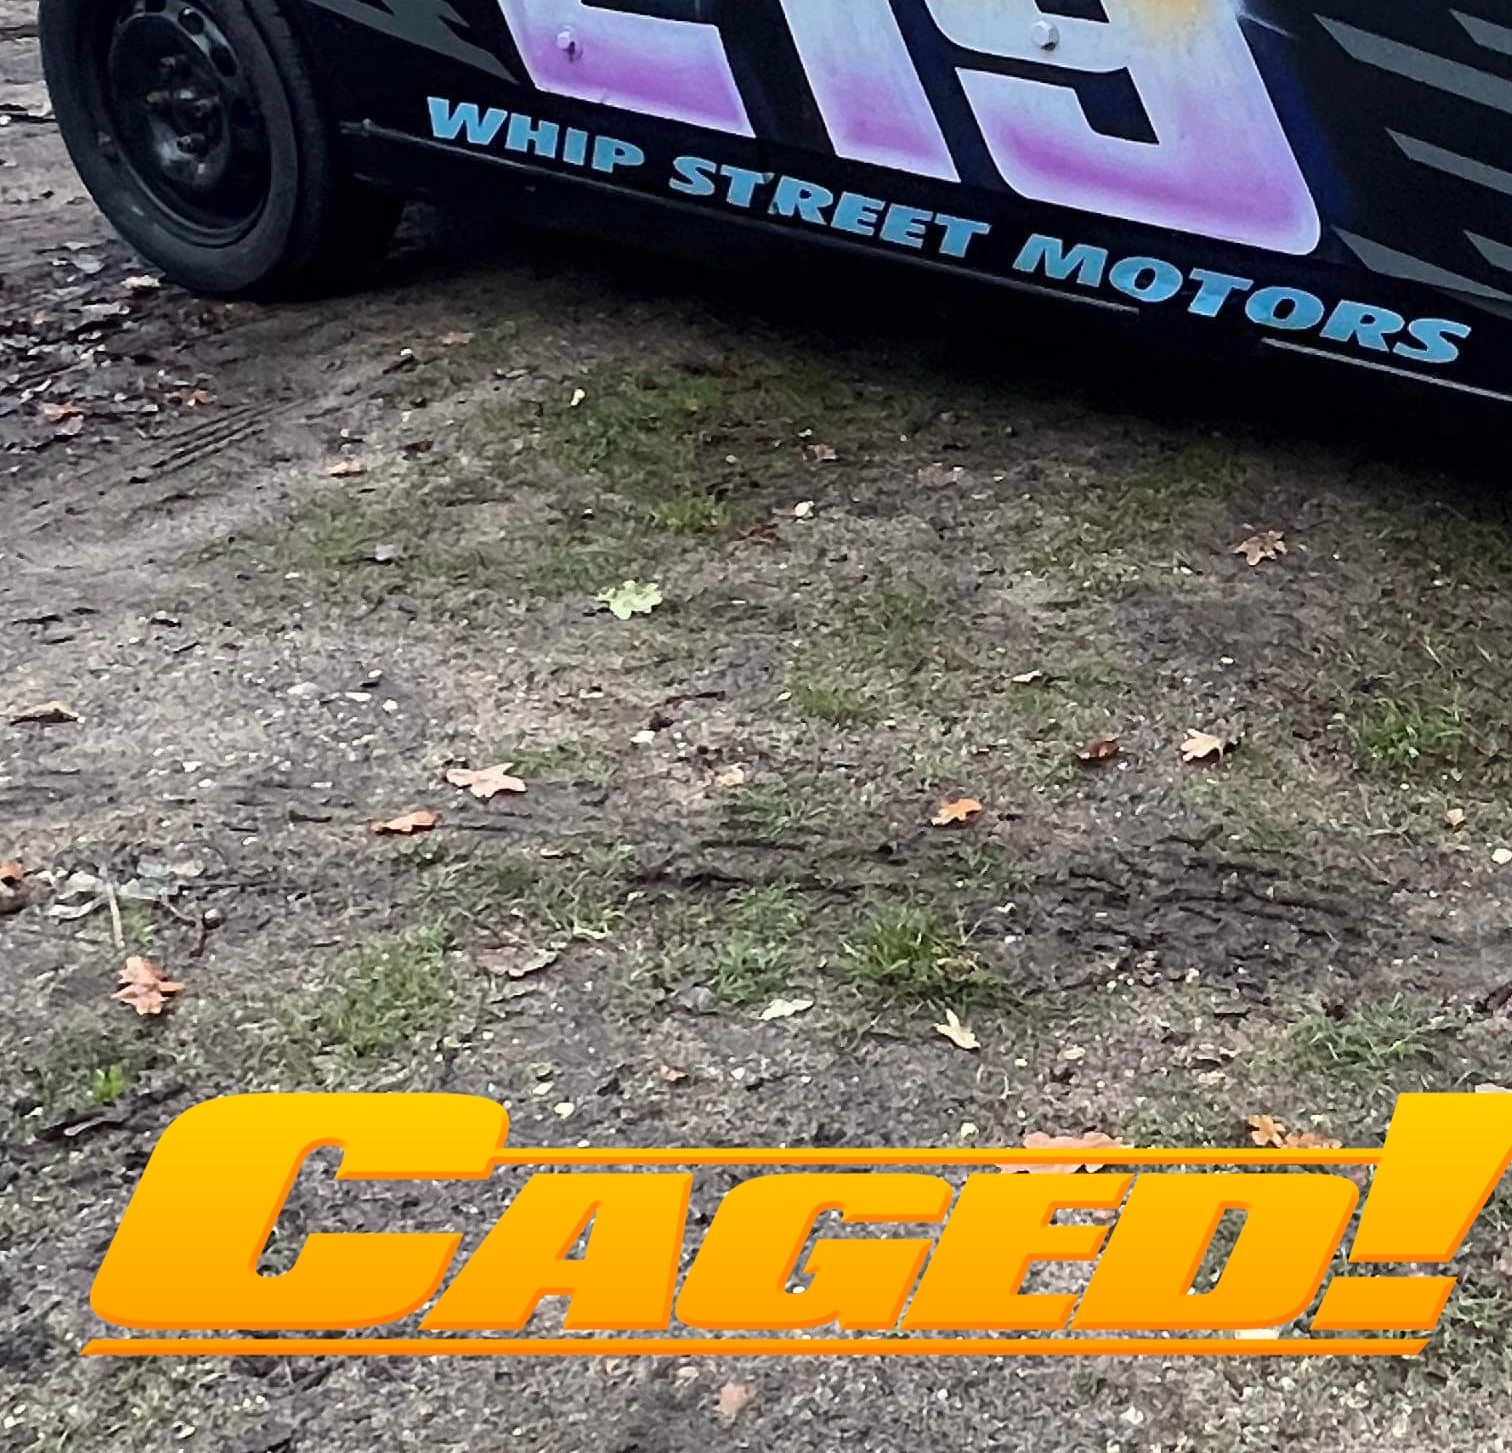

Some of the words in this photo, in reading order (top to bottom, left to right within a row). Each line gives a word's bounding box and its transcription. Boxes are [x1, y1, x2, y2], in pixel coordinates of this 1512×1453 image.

[426, 96, 646, 175] WHIP
[668, 155, 992, 258] STREET
[1012, 233, 1472, 365] MOTORS
